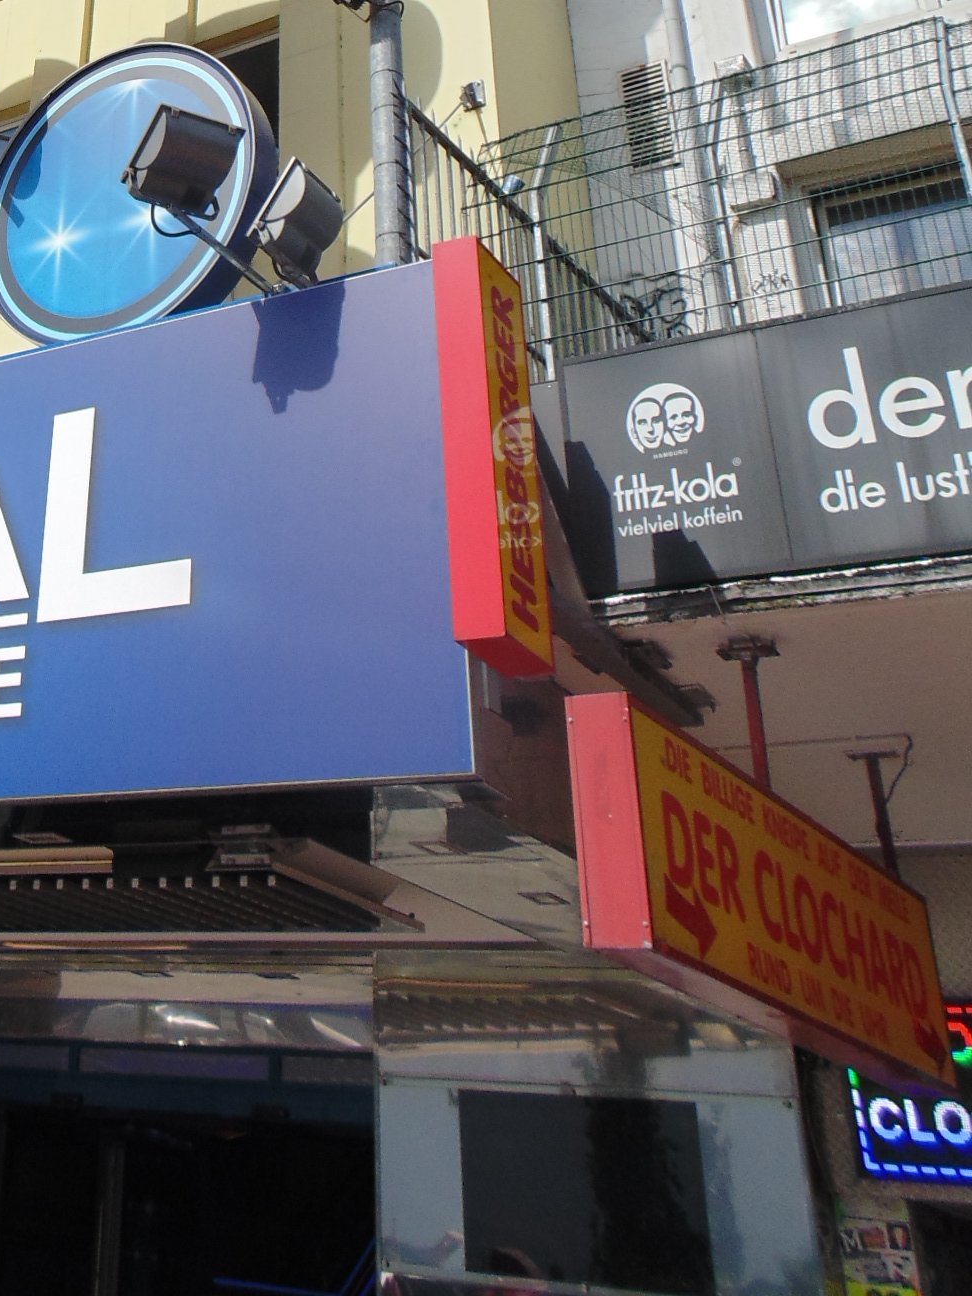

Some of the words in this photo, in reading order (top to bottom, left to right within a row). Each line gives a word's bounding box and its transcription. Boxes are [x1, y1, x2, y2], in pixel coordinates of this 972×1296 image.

[491, 285, 539, 633] HESBURGER
[653, 448, 688, 459] HAMBURG
[820, 469, 886, 513] die
[896, 451, 972, 503] lust
[613, 461, 739, 513] fritz-kola
[618, 512, 679, 537] vielviel
[683, 504, 743, 529] koffein
[664, 737, 692, 784] DIE
[701, 760, 755, 825] BILLIGE
[661, 790, 746, 924] DER
[753, 850, 928, 1020] CLOCHARD
[747, 941, 792, 995] RUND
